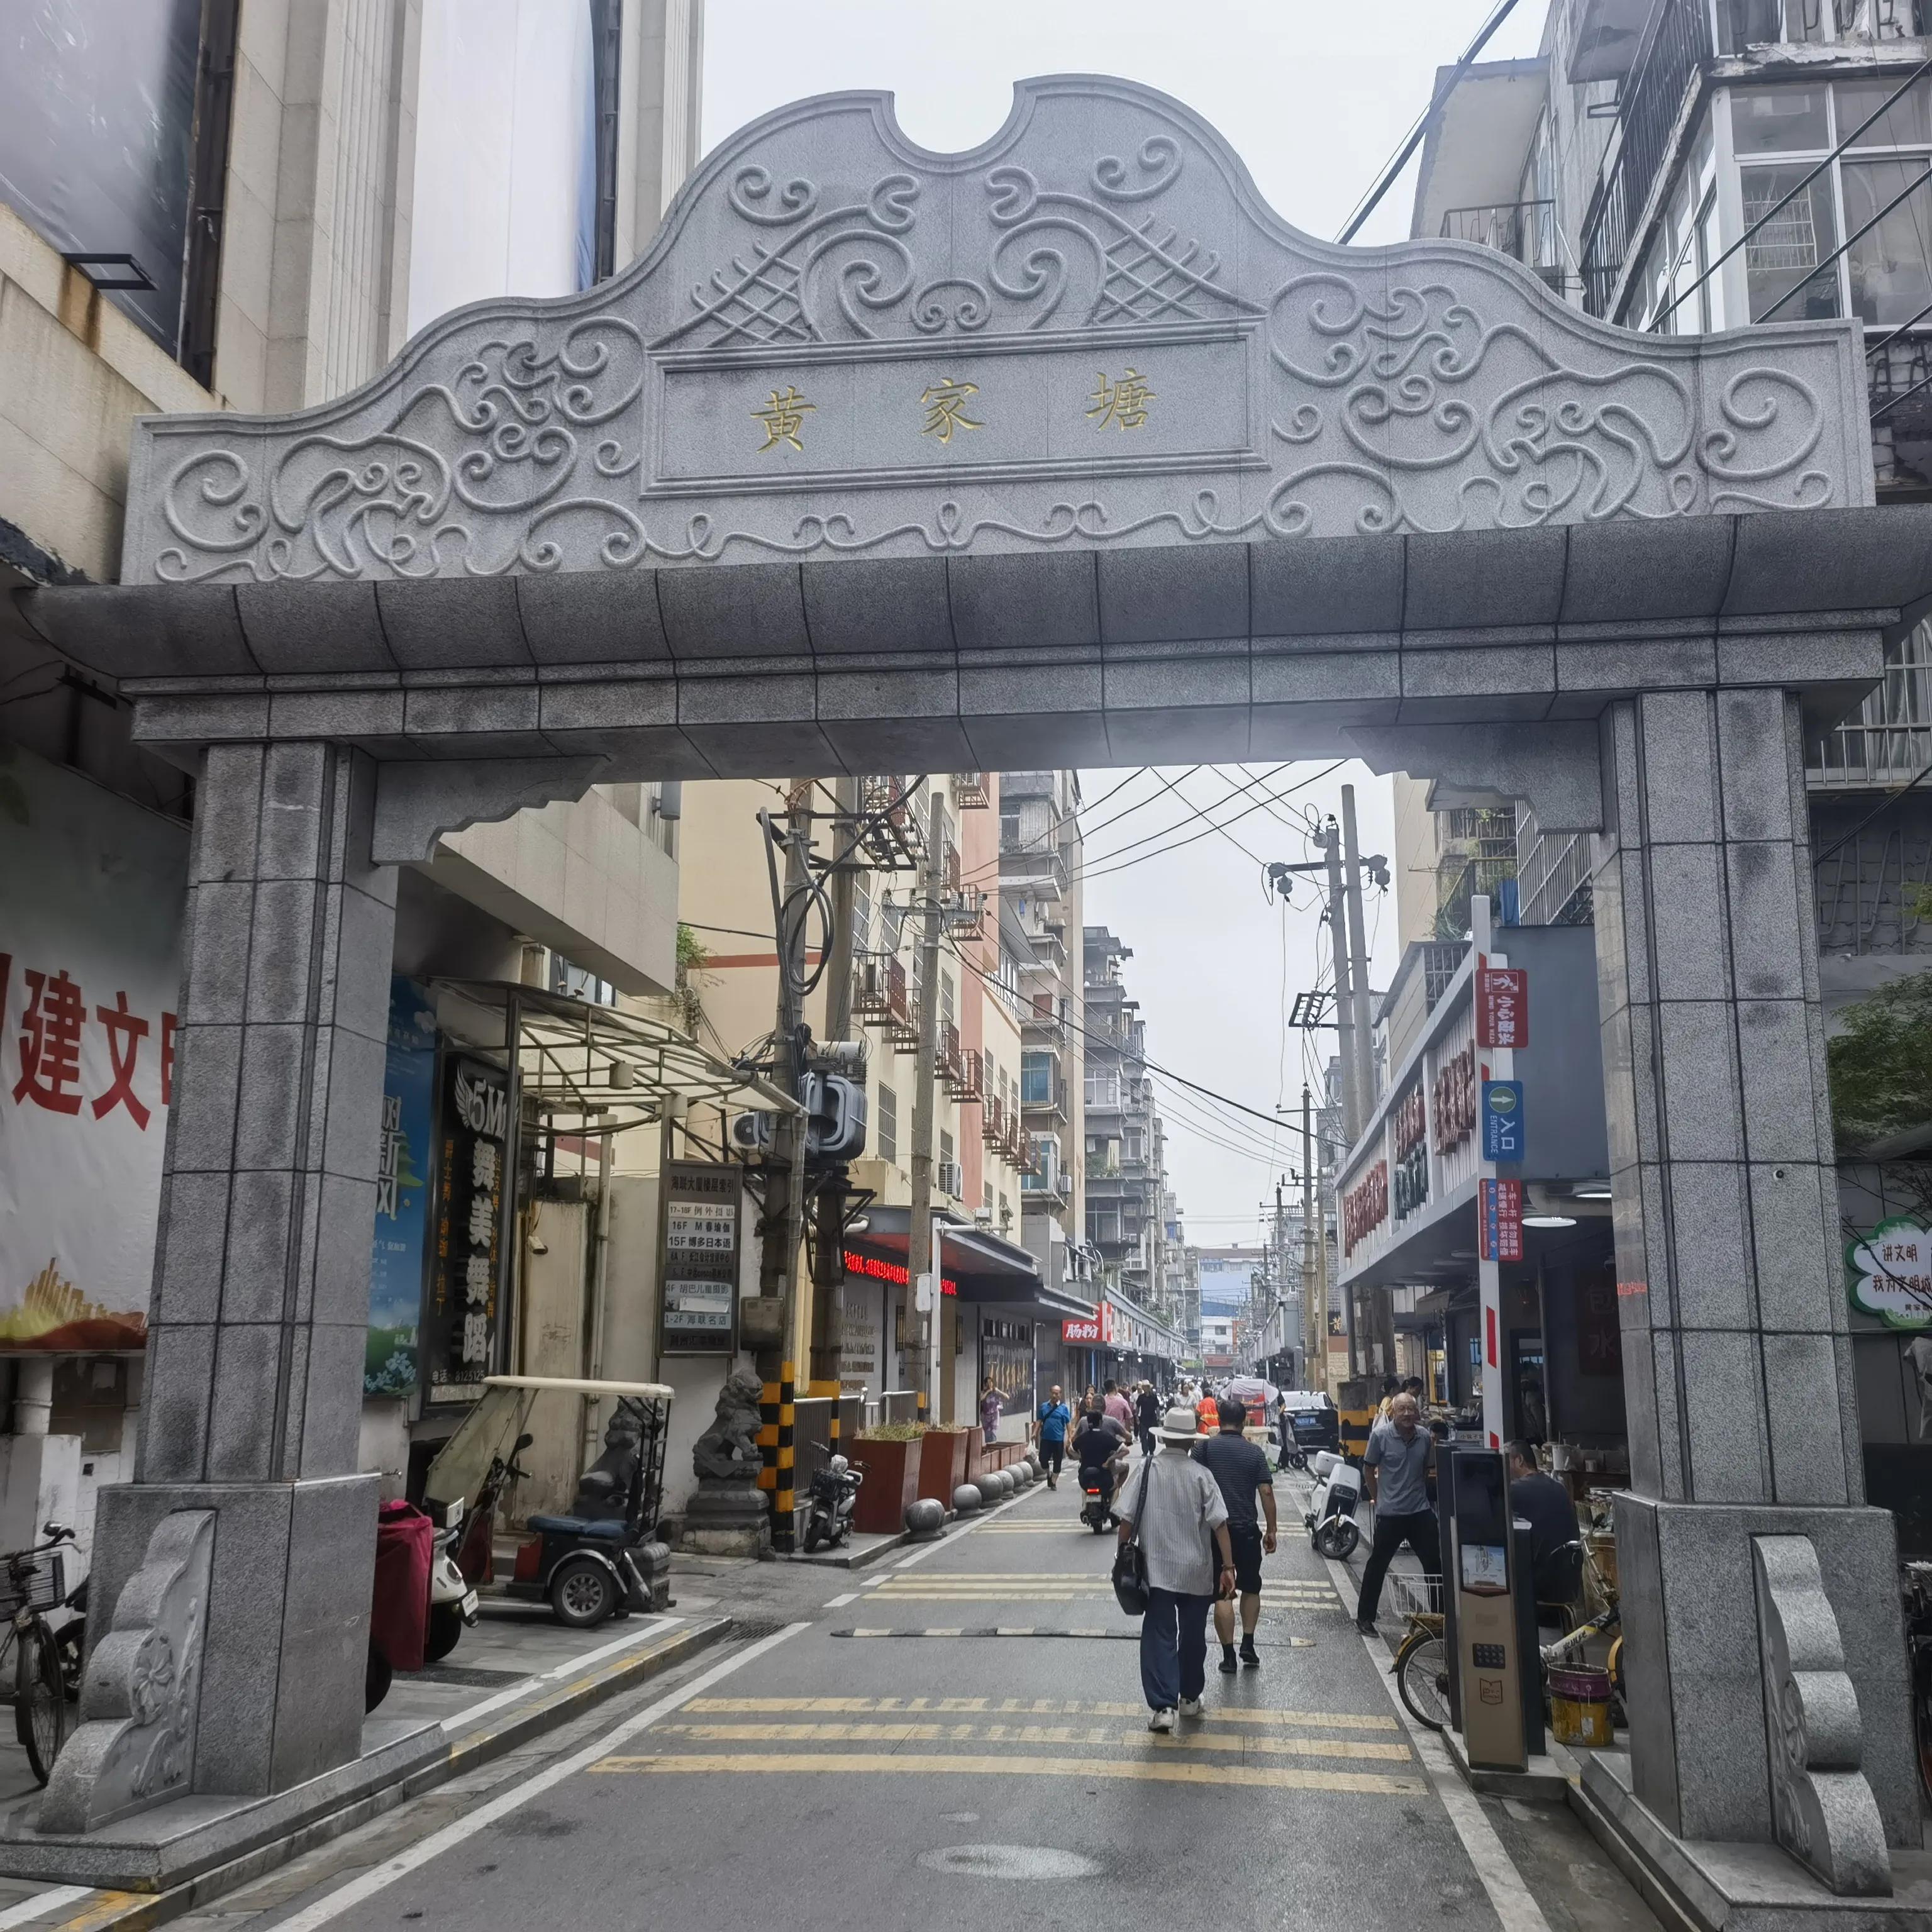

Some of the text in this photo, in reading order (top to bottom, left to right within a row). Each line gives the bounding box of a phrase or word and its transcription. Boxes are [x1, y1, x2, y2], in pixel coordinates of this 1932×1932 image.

[750, 367, 1157, 453] 黄家塘
[1497, 996, 1515, 1045] 小心碰头
[0, 953, 177, 1131] 建文
[1490, 1115, 1498, 1154] ENTRANCE
[1501, 1118, 1515, 1150] 入口
[1498, 1183, 1508, 1217] 减速慢行
[1508, 1183, 1518, 1217] 一车一杆
[669, 1236, 731, 1248] 15F 博多日本语
[672, 1221, 687, 1230] 16F
[1882, 1243, 1918, 1262] 讲文明
[665, 1314, 726, 1325] 1-2F 海联名店
[1065, 1323, 1099, 1339] 肠粉
